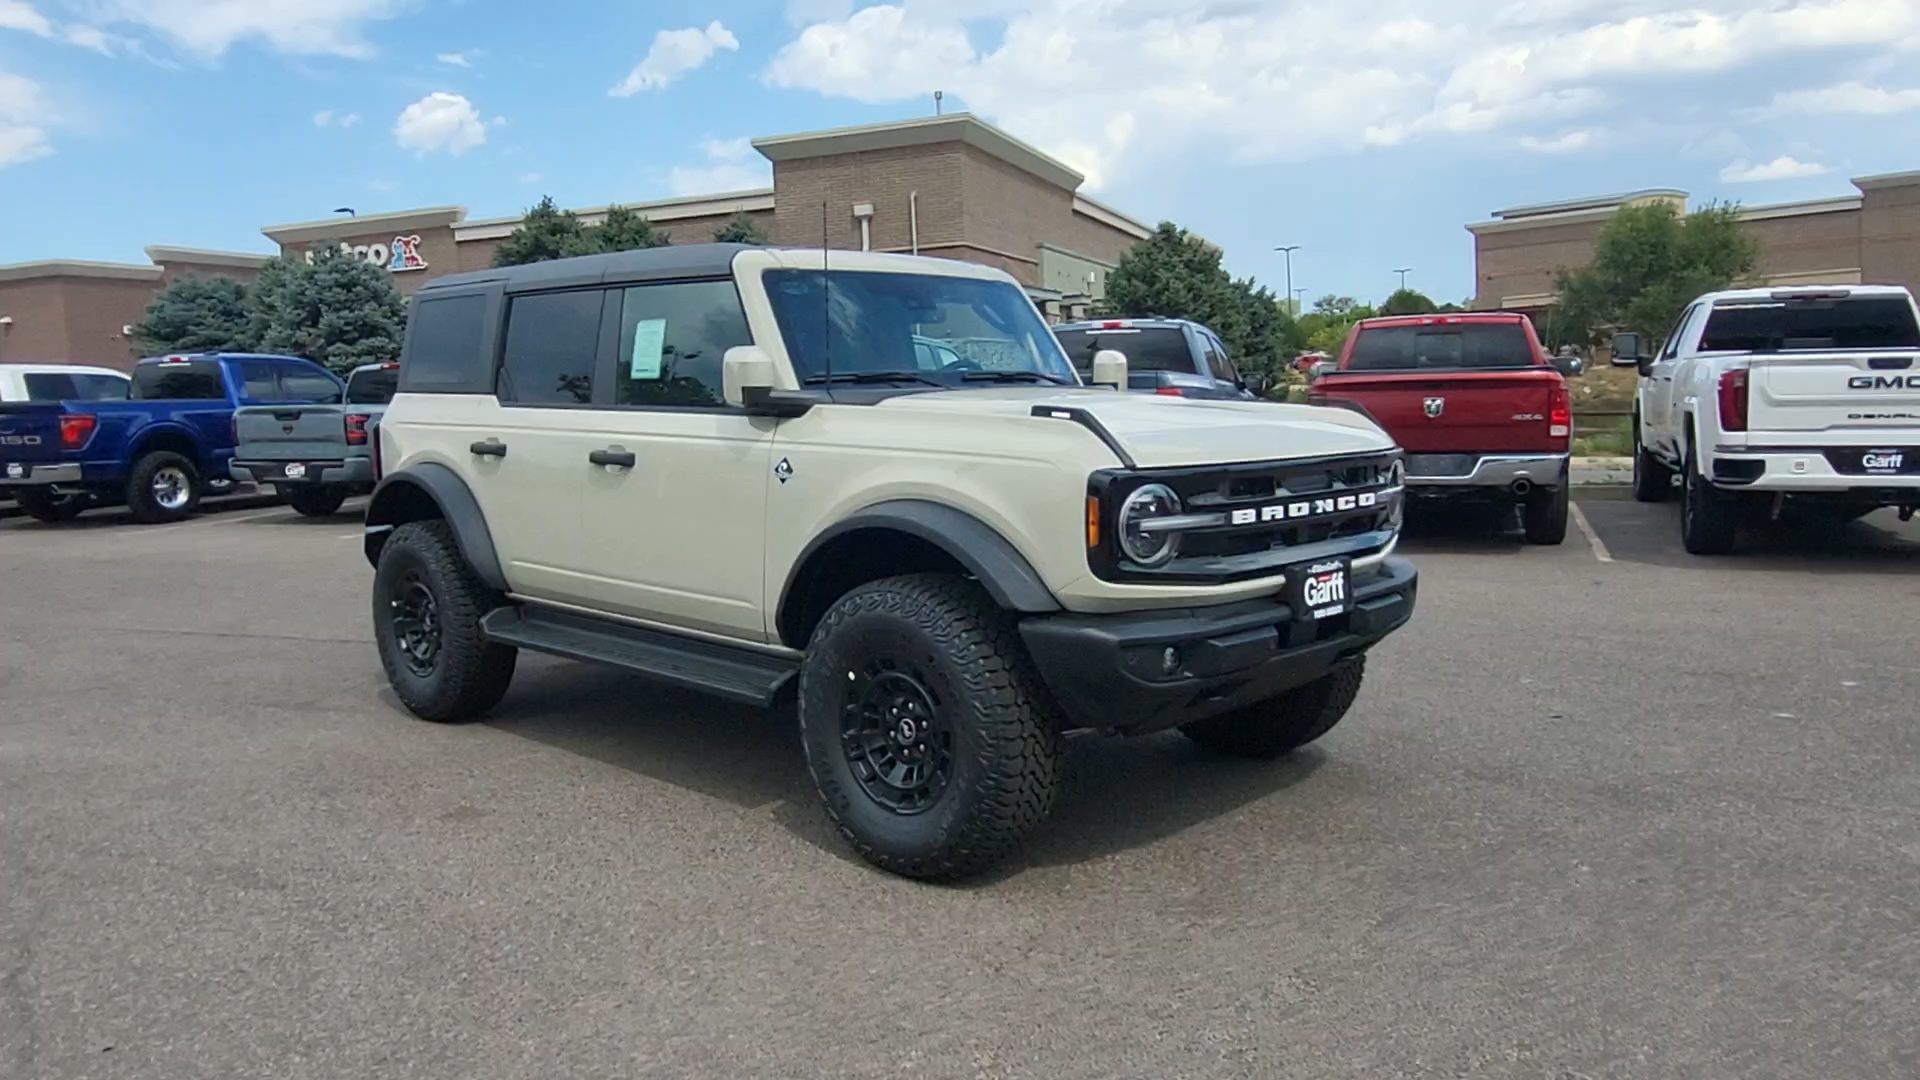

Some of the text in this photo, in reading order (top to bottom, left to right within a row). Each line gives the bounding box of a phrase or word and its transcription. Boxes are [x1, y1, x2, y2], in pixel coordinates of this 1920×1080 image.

[1848, 376, 1920, 389] GMC
[1862, 454, 1903, 468] Garff
[1231, 492, 1376, 525] BRONCO
[1304, 571, 1344, 607] Garff
